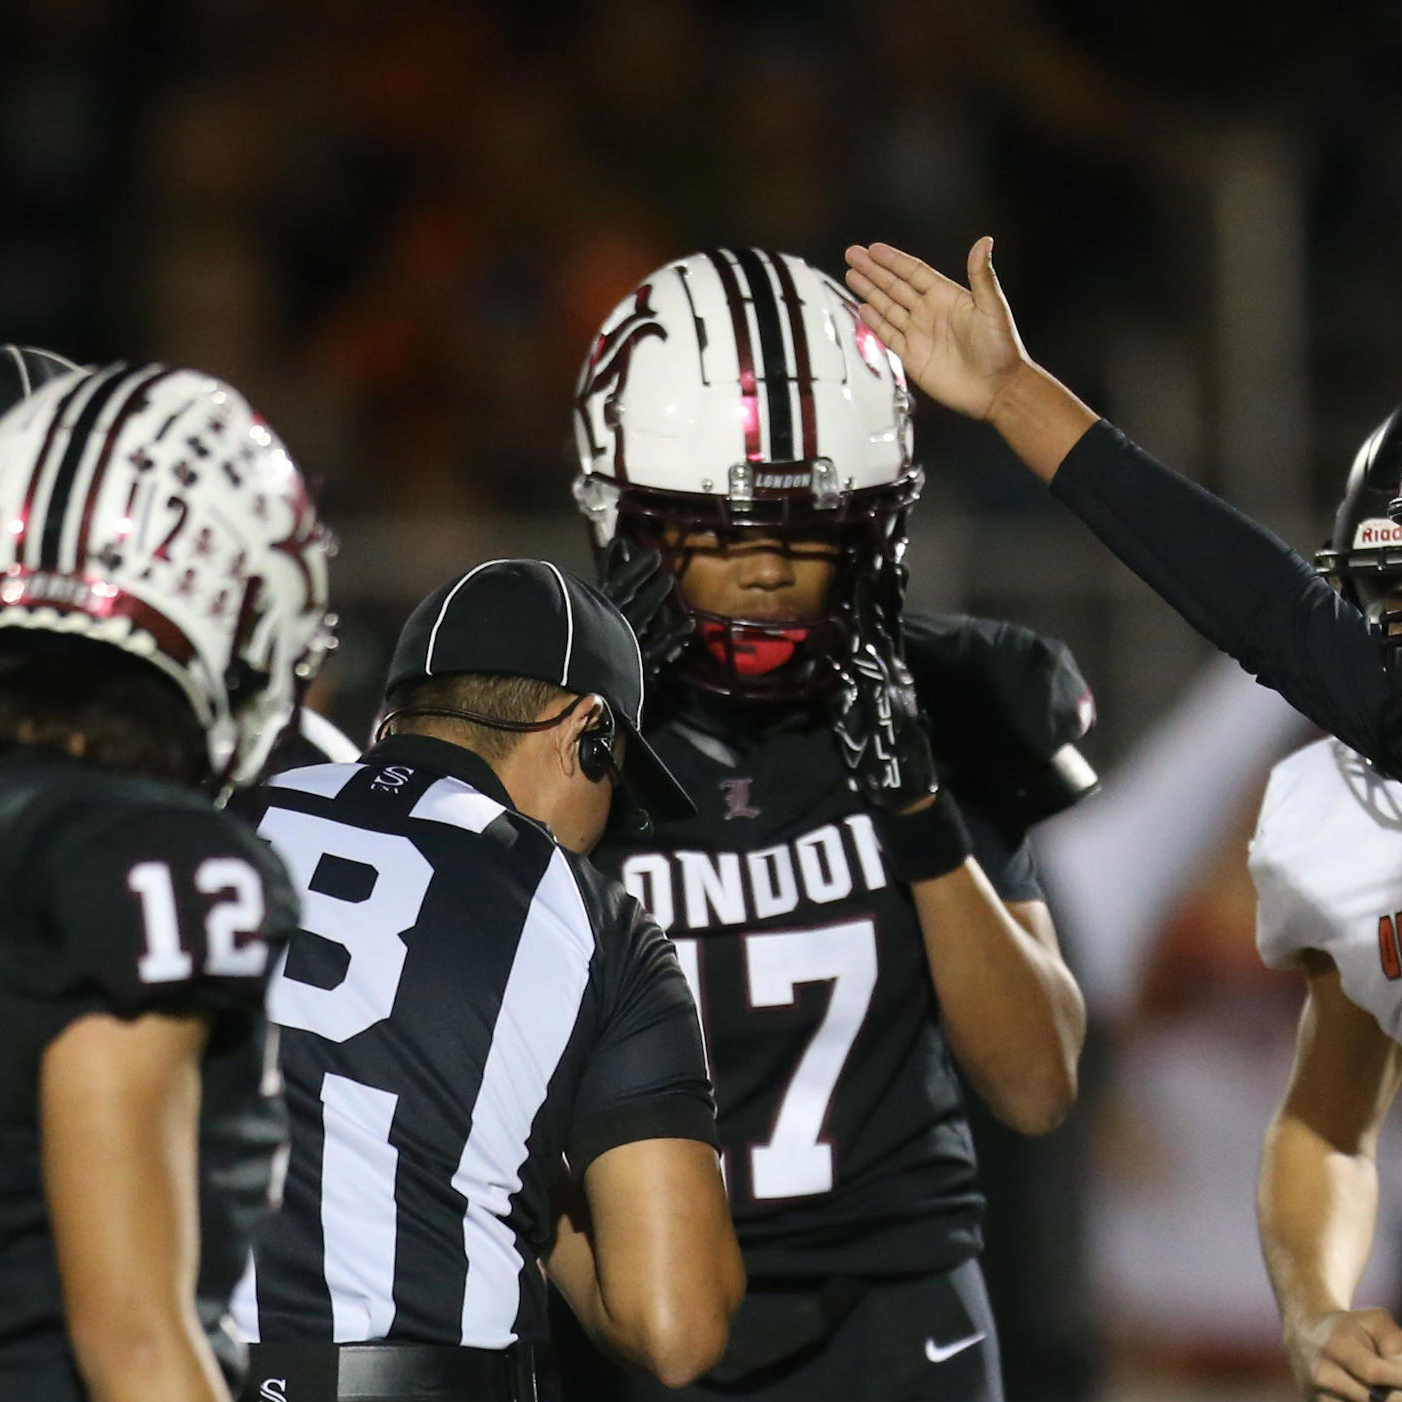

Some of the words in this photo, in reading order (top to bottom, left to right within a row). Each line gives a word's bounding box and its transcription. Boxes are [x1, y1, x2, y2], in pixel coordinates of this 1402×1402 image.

[128, 857, 269, 985] 12
[255, 806, 435, 1044] B
[622, 813, 888, 931] ONDO
